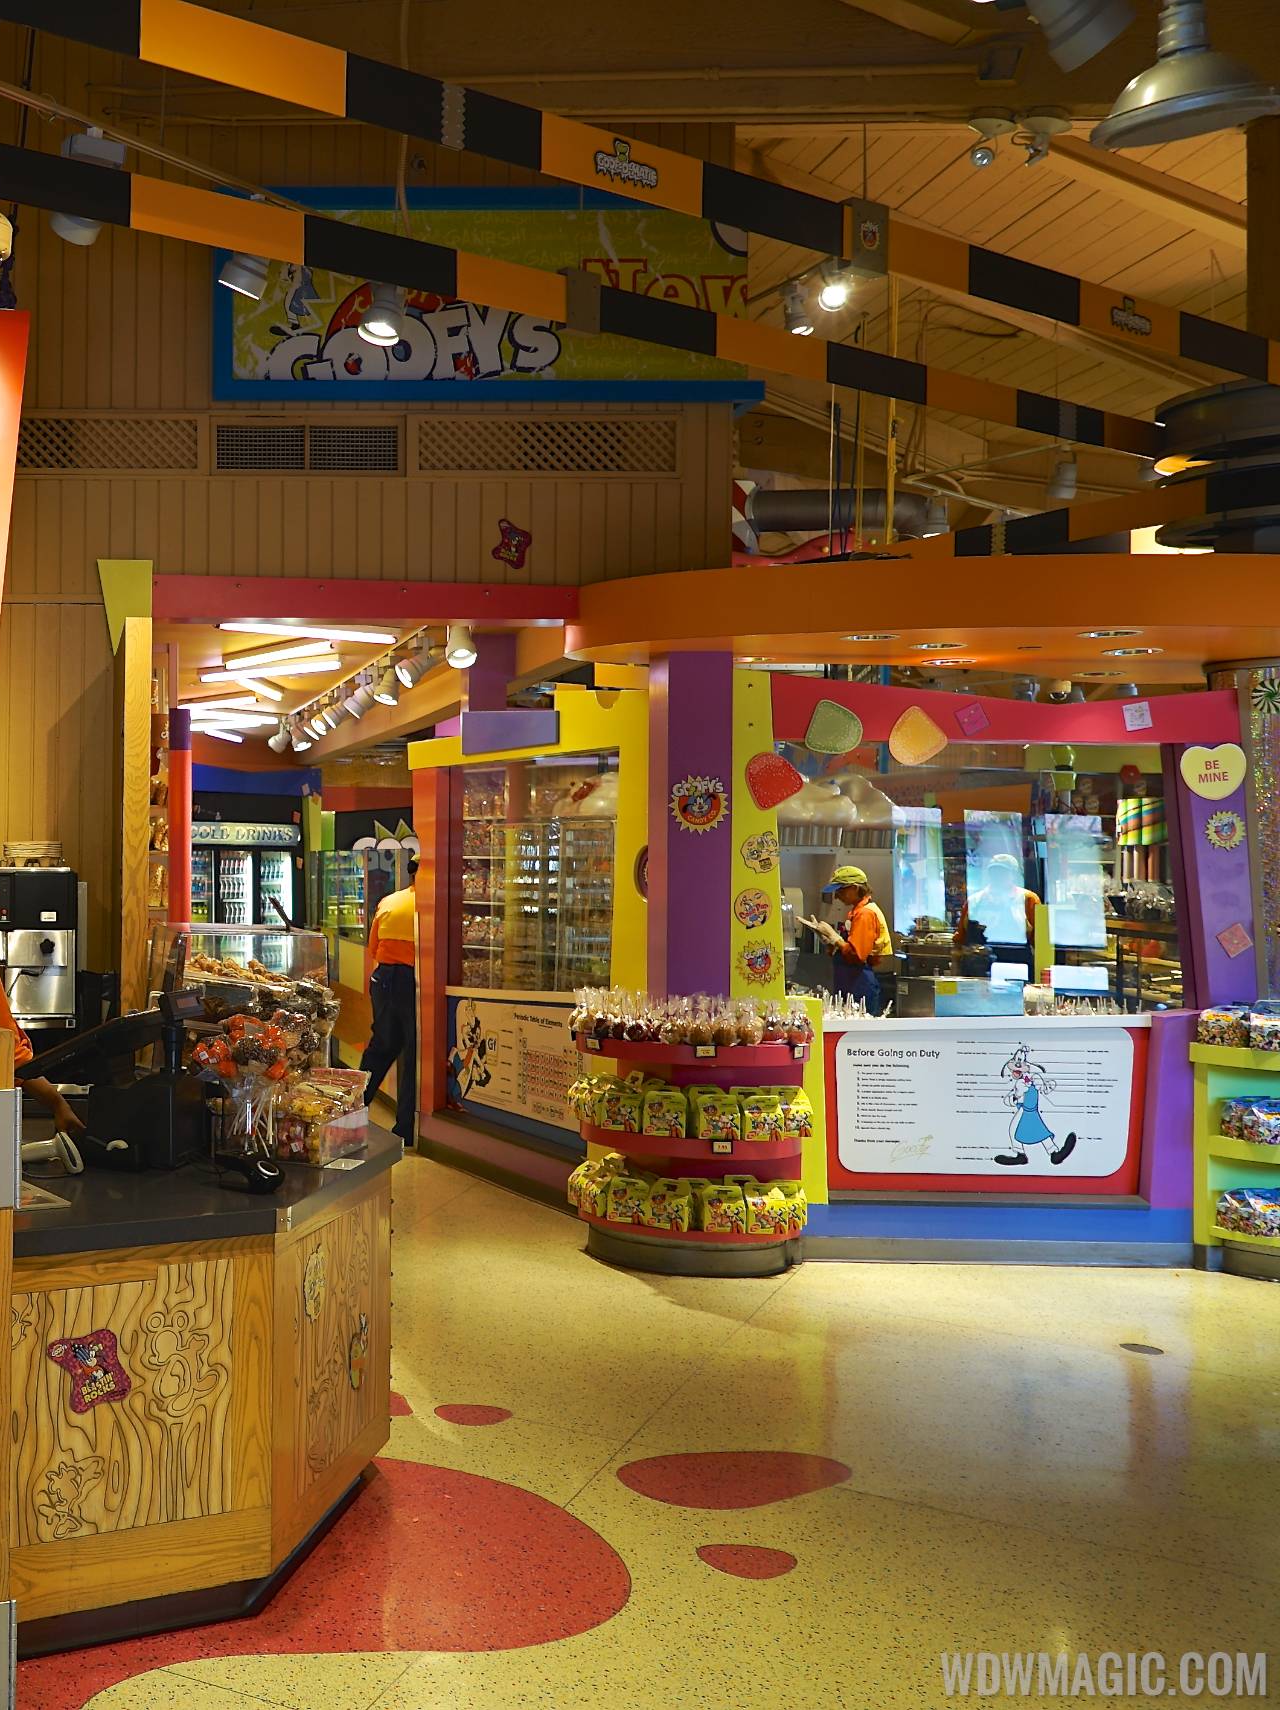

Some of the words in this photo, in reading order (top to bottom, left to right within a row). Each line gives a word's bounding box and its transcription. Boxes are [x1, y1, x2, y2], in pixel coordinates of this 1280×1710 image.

[1204, 759, 1220, 771] BE
[1198, 771, 1229, 784] MINE
[672, 777, 724, 799] GOOFY'S
[686, 813, 708, 825] CANDY
[191, 824, 230, 840] COLD
[235, 825, 294, 842] DRINKS
[846, 1048, 875, 1057] Before
[919, 1049, 941, 1060] Duty
[84, 1381, 117, 1404] ROCKS
